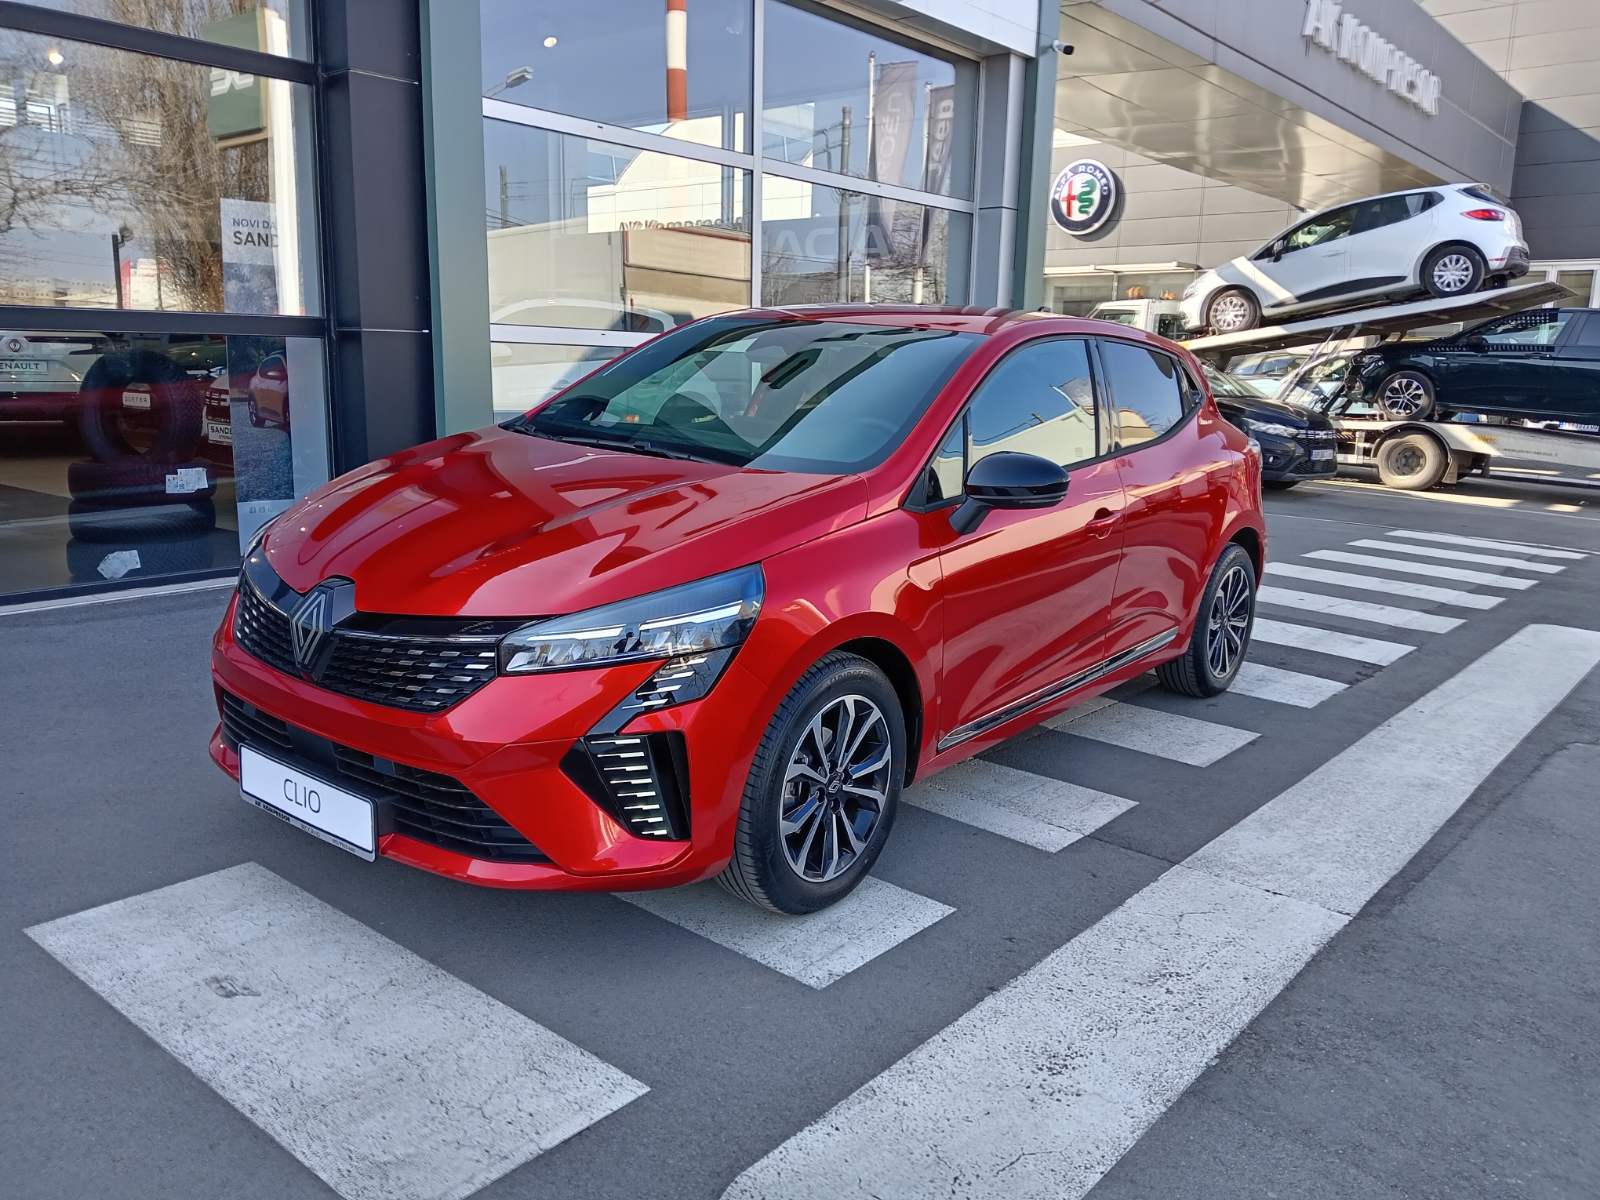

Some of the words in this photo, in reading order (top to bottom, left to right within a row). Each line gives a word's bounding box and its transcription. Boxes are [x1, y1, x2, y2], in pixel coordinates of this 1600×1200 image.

[1054, 170, 1074, 199] ALFA
[1078, 164, 1109, 196] ROMEO
[232, 217, 260, 228] NOVI
[232, 230, 279, 247] SAND
[0, 361, 41, 370] ENAULT
[209, 425, 232, 435] SAND
[283, 778, 321, 814] CLIO
